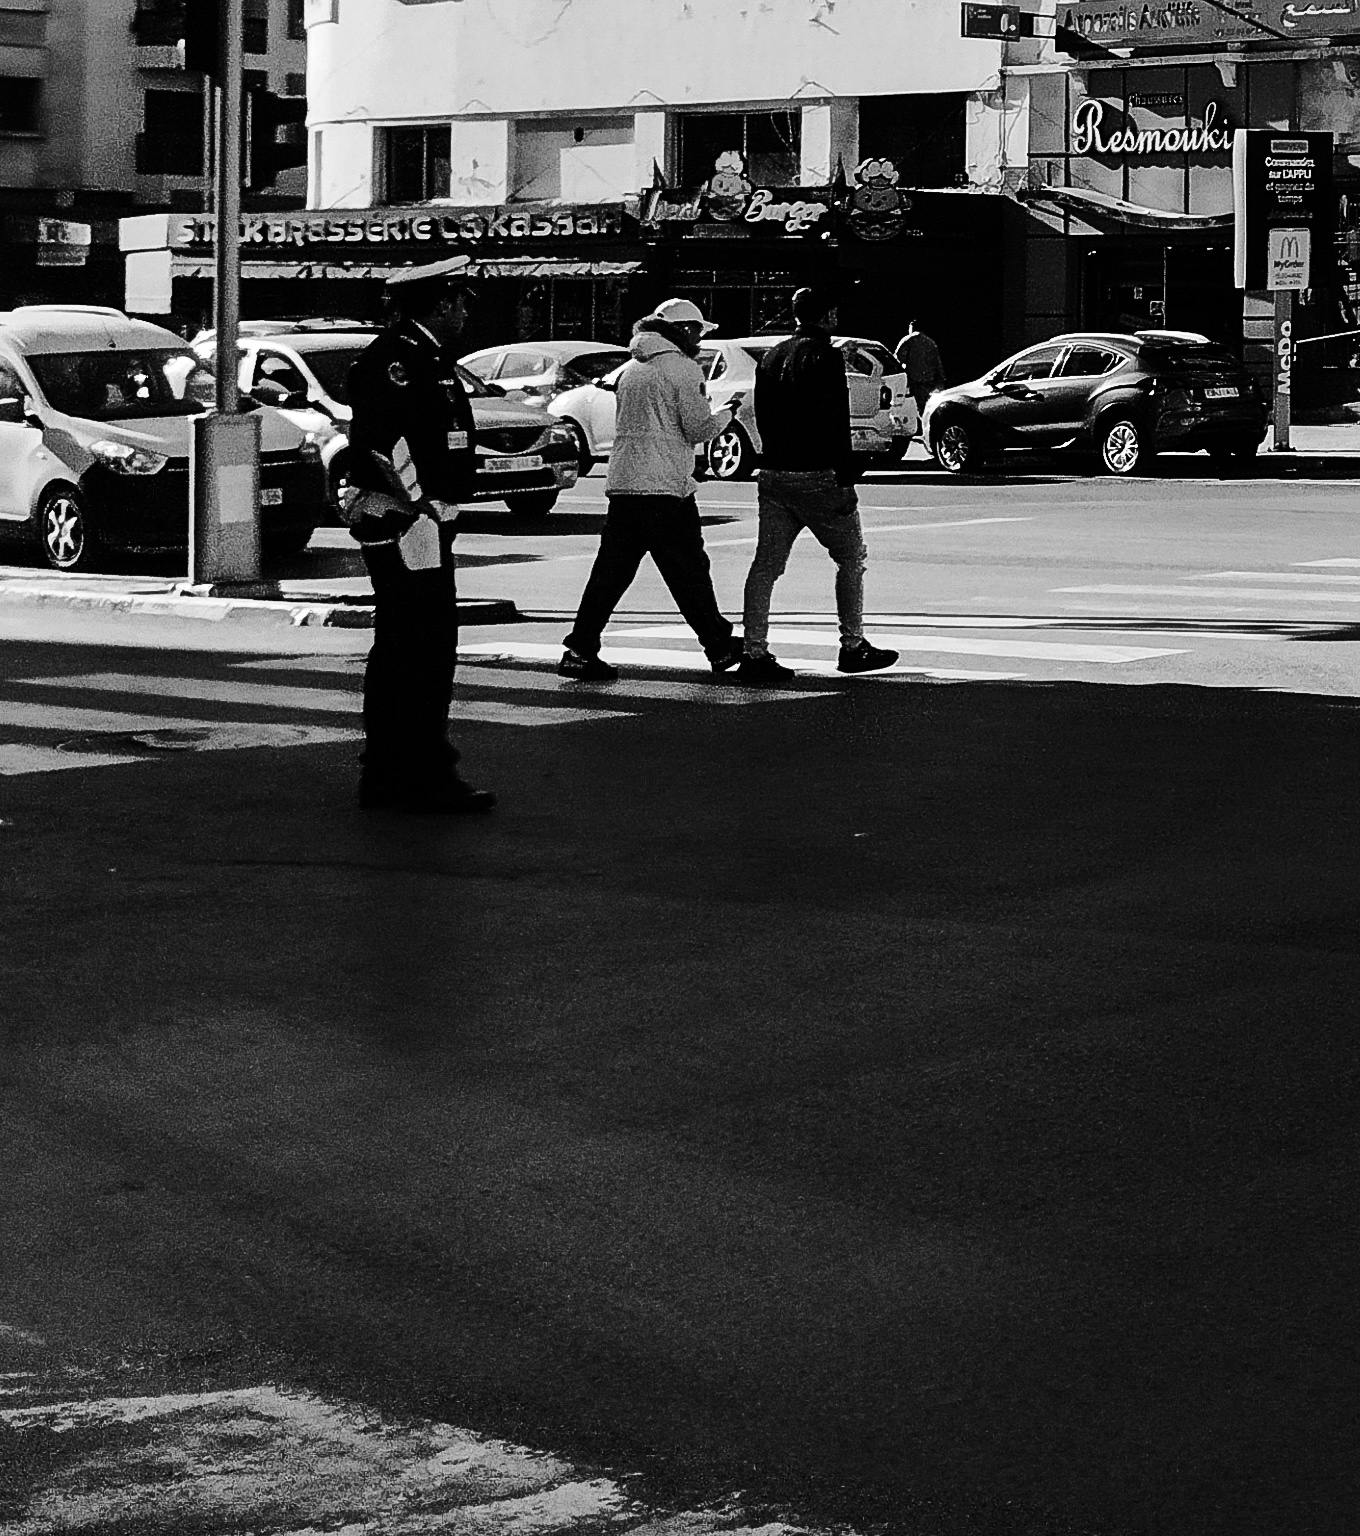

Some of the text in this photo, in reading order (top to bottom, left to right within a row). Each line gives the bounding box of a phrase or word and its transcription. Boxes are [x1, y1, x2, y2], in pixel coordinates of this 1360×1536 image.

[1073, 99, 1234, 154] Resmouki
[744, 189, 829, 232] Burger
[1277, 319, 1292, 395] McDo
